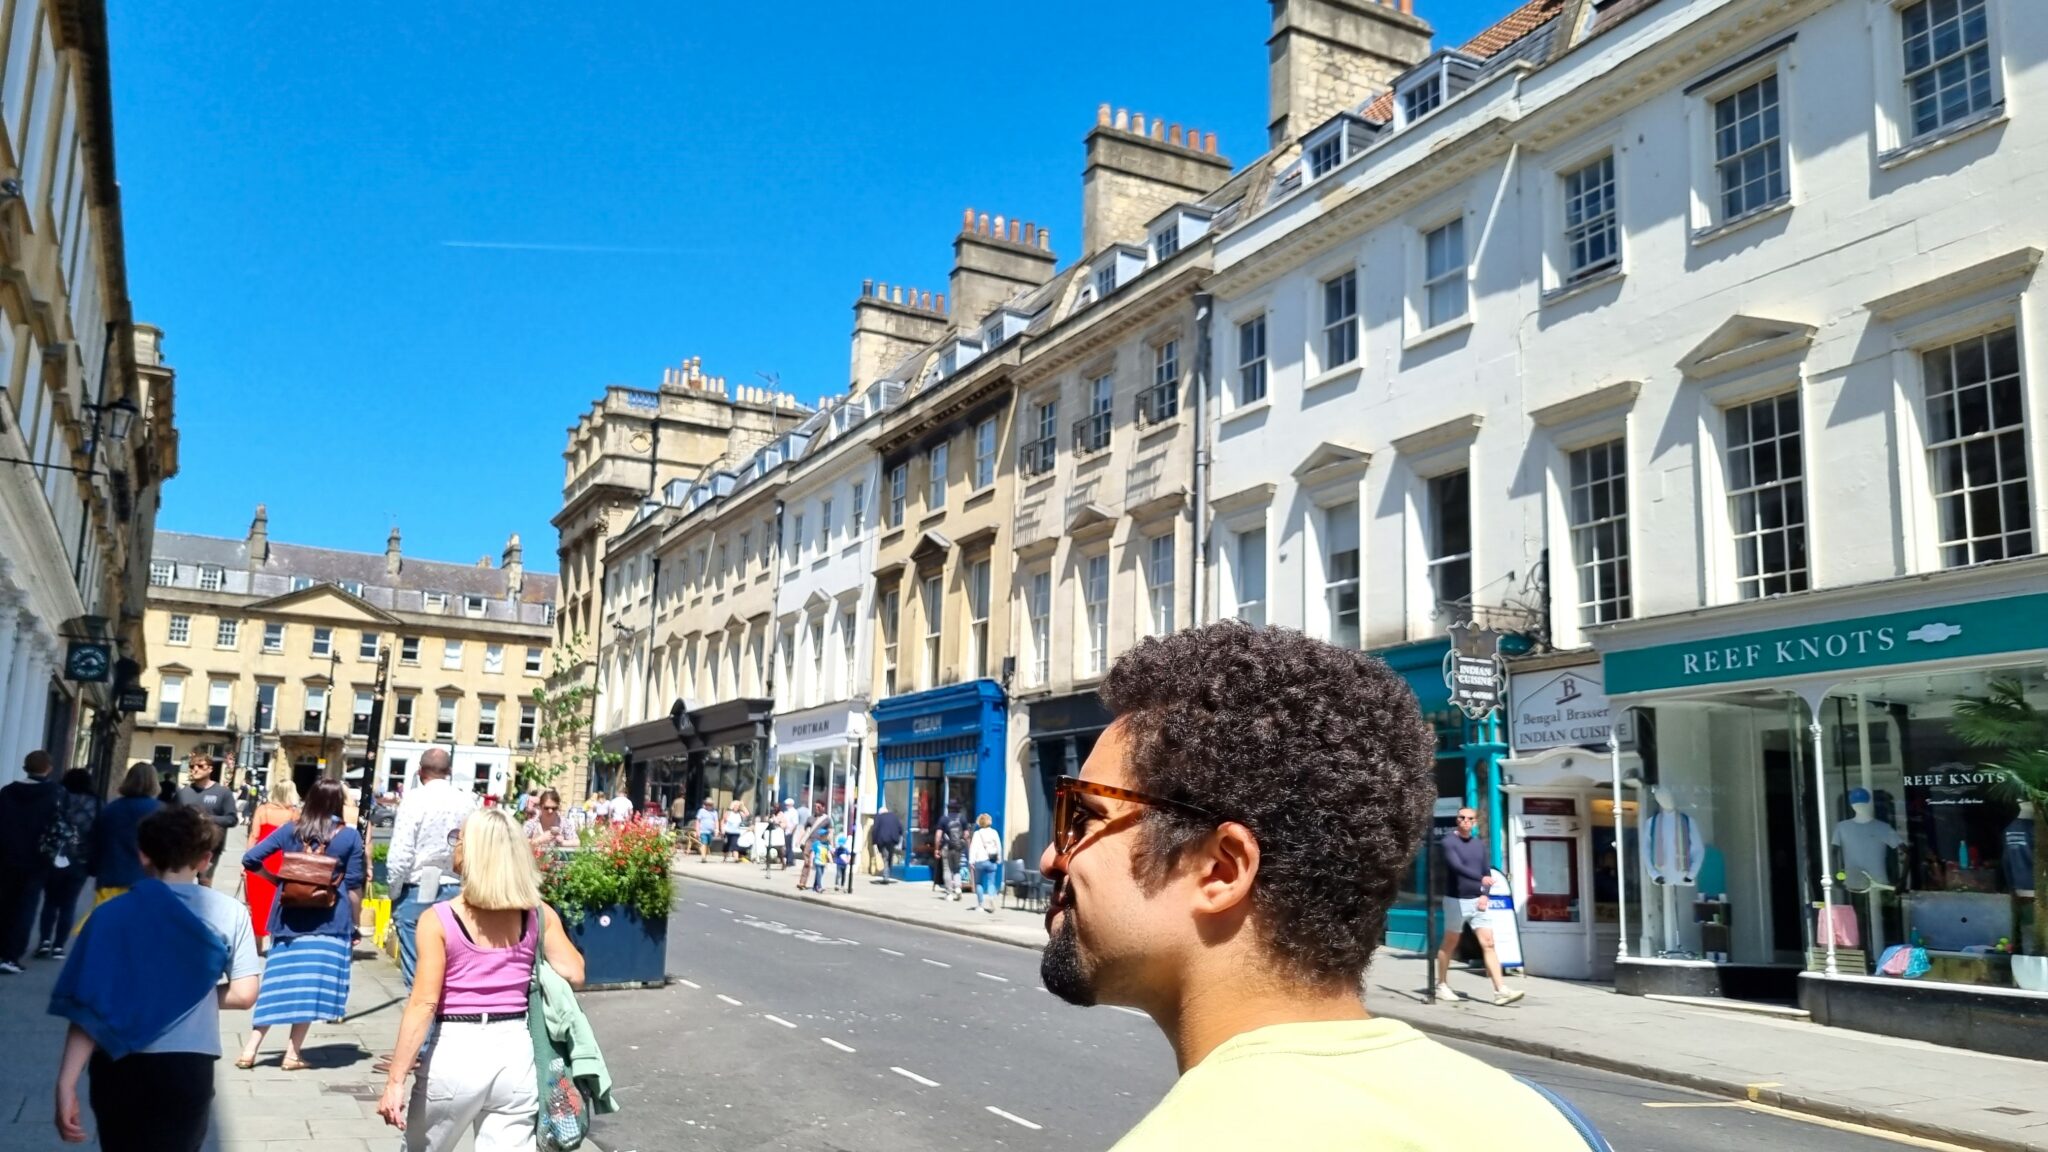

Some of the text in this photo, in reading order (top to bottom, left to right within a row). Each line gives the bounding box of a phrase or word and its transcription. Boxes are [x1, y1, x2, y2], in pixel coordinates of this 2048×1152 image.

[1682, 626, 1895, 676] REEF KNOTS
[1459, 664, 1494, 676] INDIAN
[1561, 678, 1576, 697] B
[1523, 708, 1609, 727] Bengal Brasser
[792, 719, 830, 737] PORTMAN
[1520, 729, 1566, 744] INDIAN
[1903, 772, 2006, 786] REEF KNOTS
